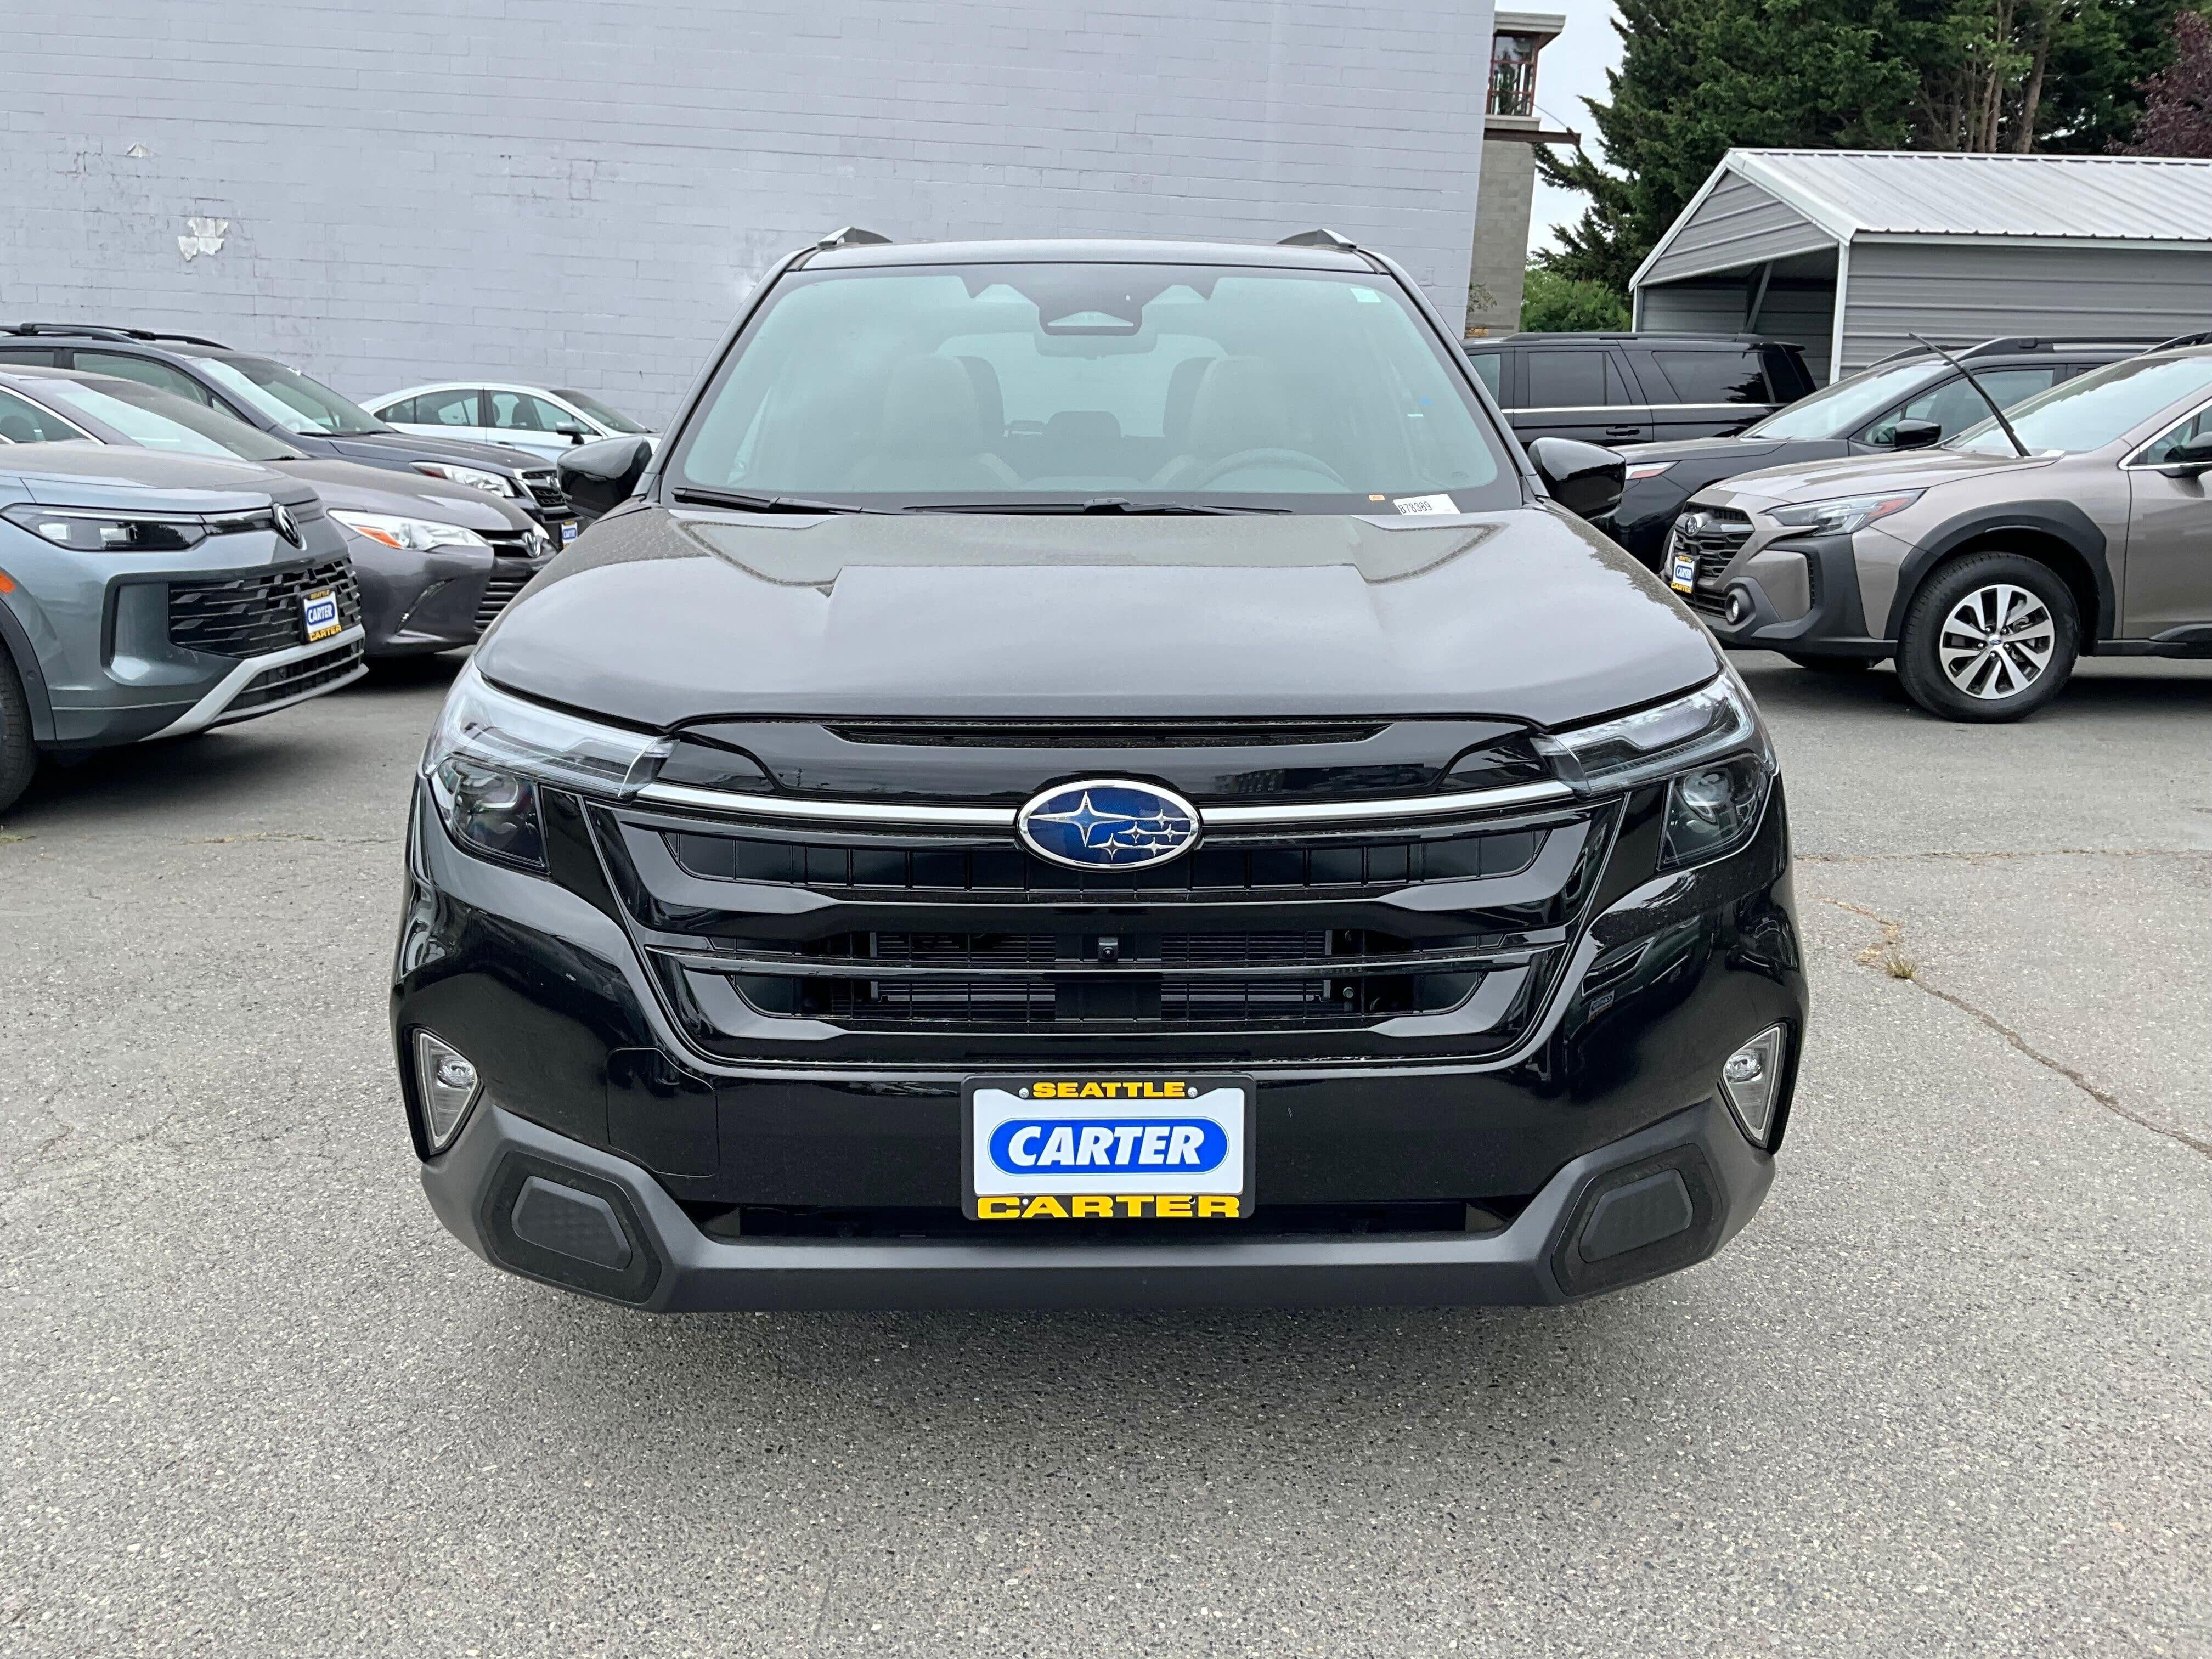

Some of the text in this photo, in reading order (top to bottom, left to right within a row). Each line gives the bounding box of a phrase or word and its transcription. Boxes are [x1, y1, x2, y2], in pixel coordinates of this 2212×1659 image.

[1397, 501, 1432, 514] B78389
[1671, 582, 1693, 594] CARTER
[308, 603, 333, 624] CARTER
[309, 624, 342, 642] CARTER
[1032, 1082, 1186, 1098] SEATTLE
[1008, 1126, 1205, 1166] CARTER
[977, 1195, 1240, 1219] CARTER
